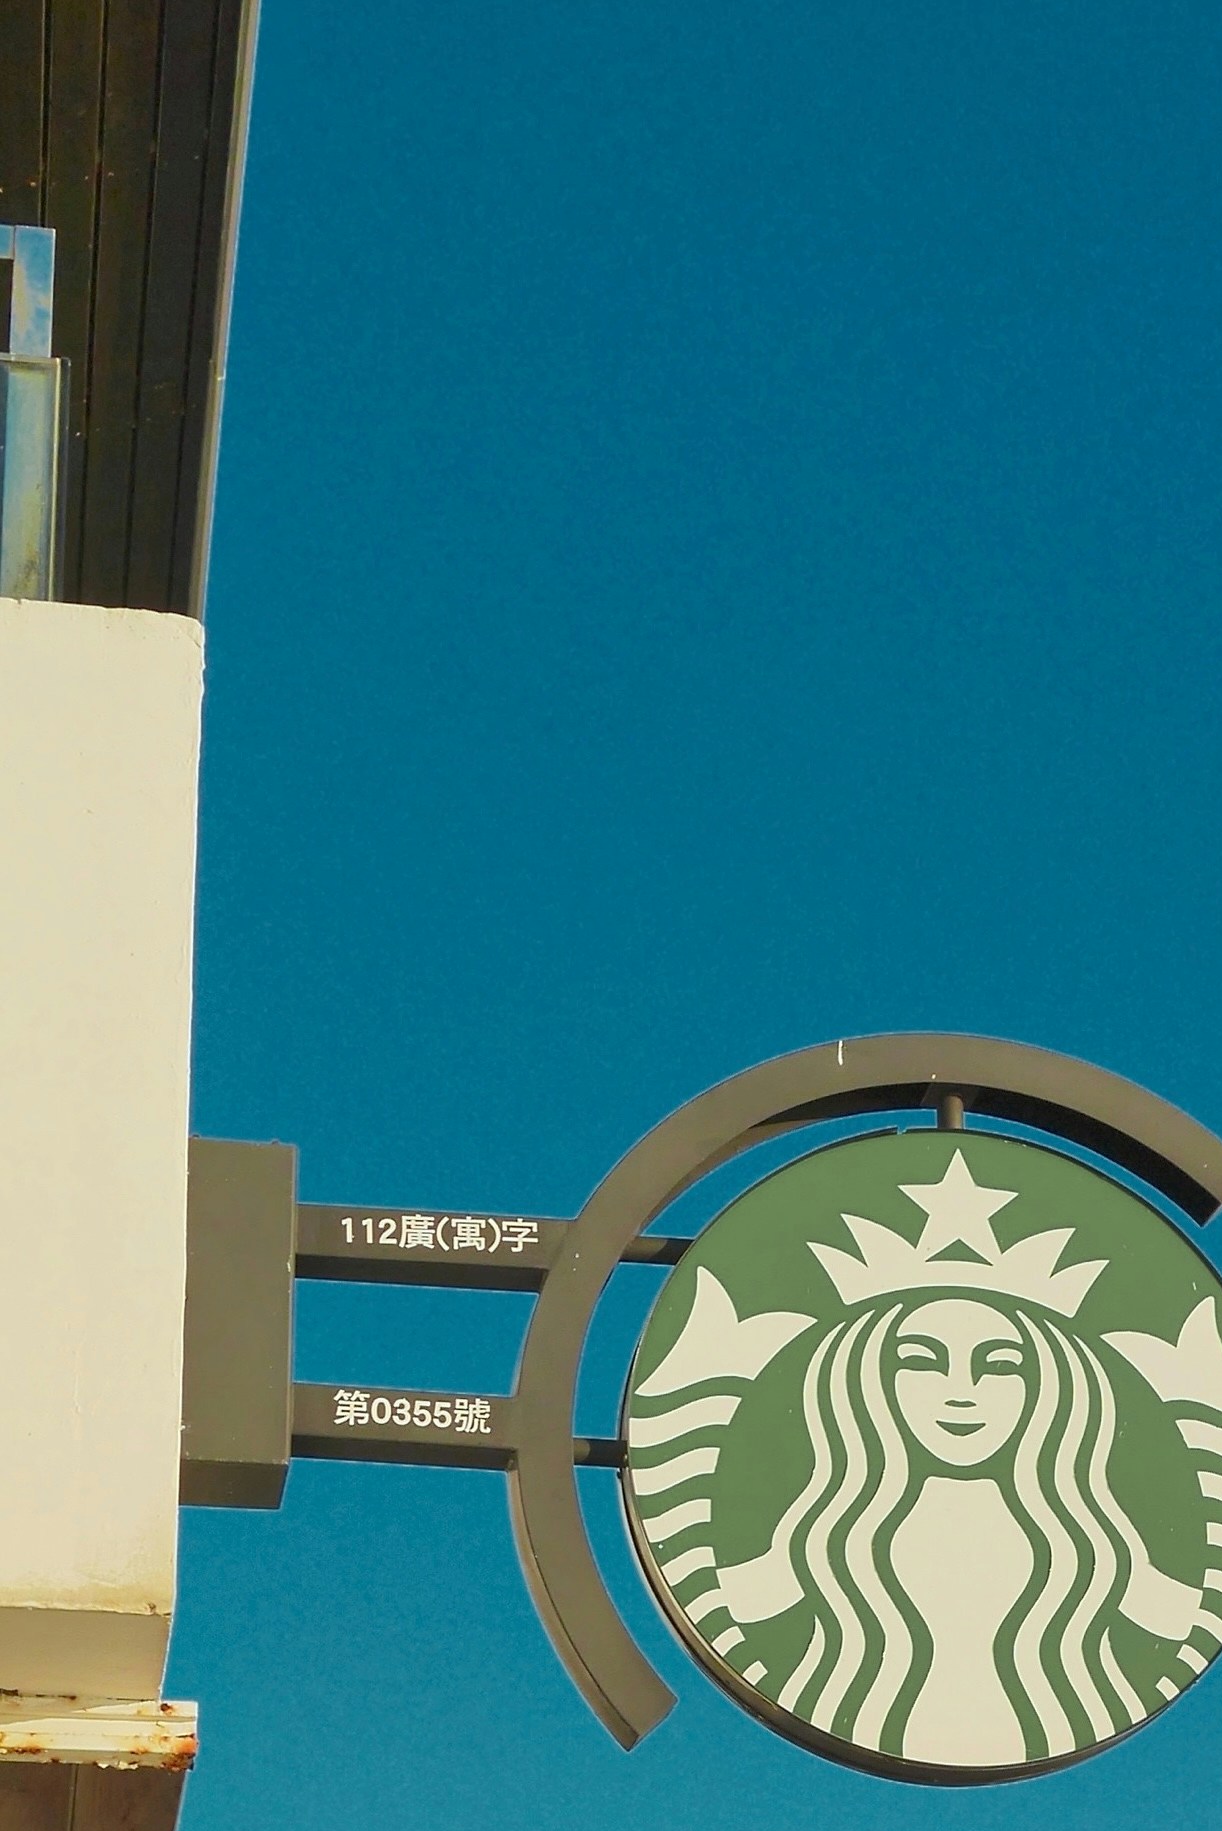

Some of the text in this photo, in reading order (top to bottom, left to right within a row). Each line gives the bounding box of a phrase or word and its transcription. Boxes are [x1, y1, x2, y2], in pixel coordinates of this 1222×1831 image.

[342, 1214, 538, 1252] 112廣(寓)字
[334, 1390, 491, 1433] 第0355號
